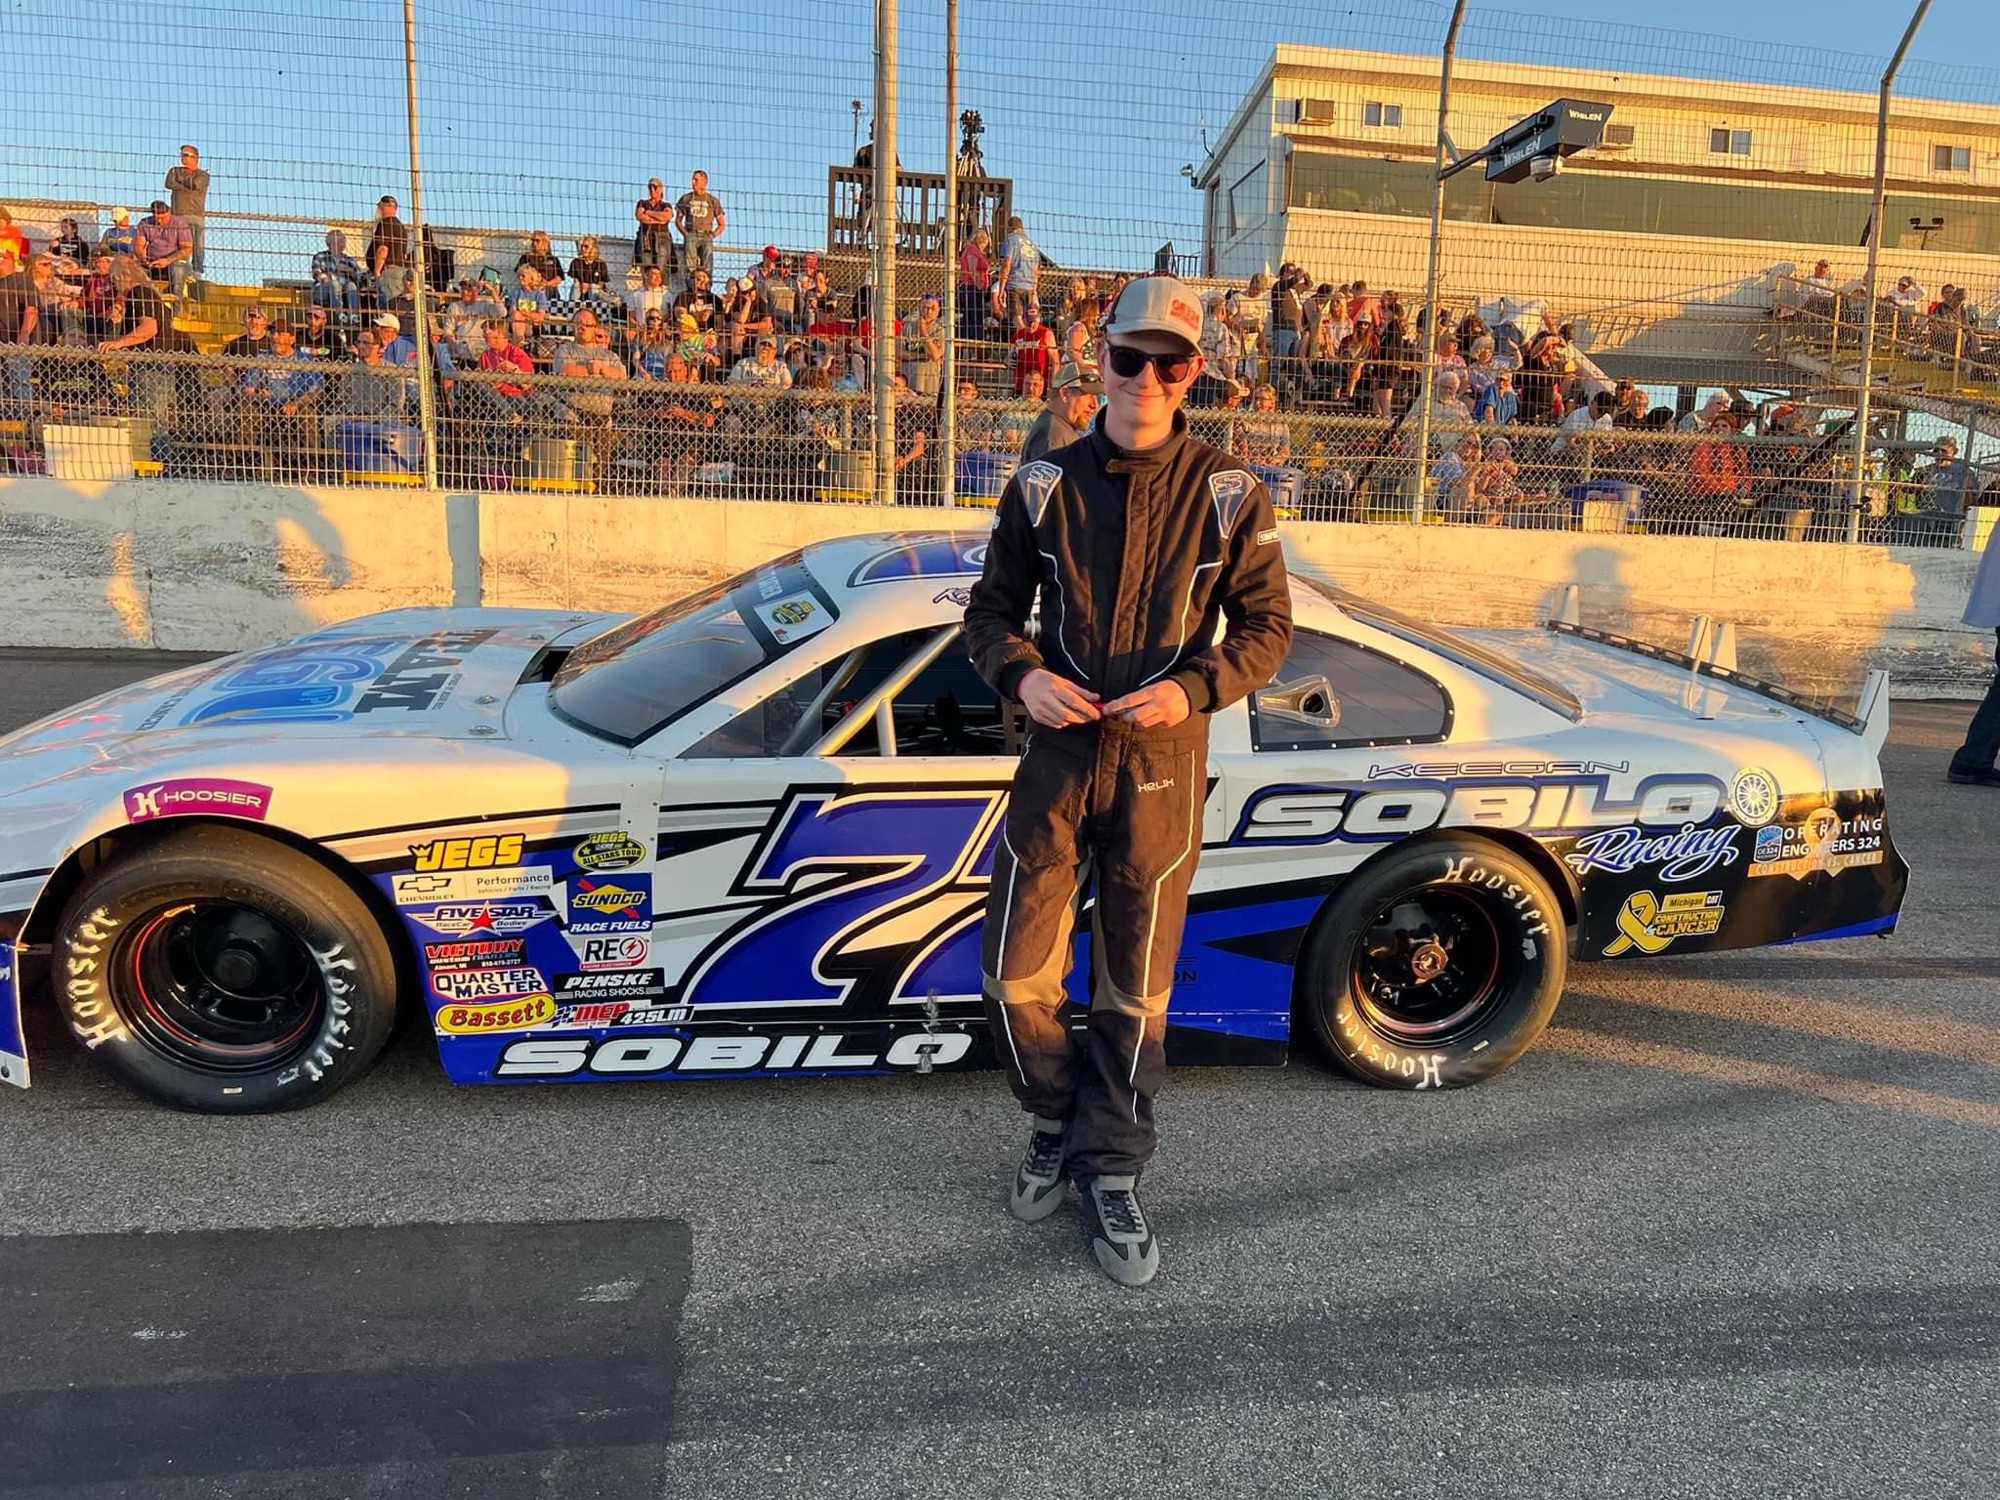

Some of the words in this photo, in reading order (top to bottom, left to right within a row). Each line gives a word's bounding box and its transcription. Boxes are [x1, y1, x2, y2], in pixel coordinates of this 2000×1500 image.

[1569, 109, 1602, 121] WHELEN
[1504, 137, 1541, 167] WHELEN
[353, 629, 501, 713] TEAM
[1368, 760, 1630, 780] KEEGAN
[163, 789, 263, 809] HOOSIER
[1240, 780, 1723, 839] SOBILO
[591, 832, 627, 844] JEGS
[1784, 819, 1883, 840] OPERATING
[1857, 836, 1881, 849] 324
[414, 834, 525, 873] JEGS
[622, 849, 642, 857] TOUR
[1566, 823, 1741, 882] Racing
[1844, 855, 1877, 867] CANCER
[476, 874, 550, 886] Performance
[400, 894, 454, 903] CHEVROLET
[575, 892, 646, 907] SUNOCO
[1443, 857, 1550, 936] Hoosier
[1669, 898, 1702, 906] Michigan
[1706, 895, 1719, 904] CAT
[436, 906, 483, 920] FIVE
[488, 906, 535, 918] STAR
[1655, 910, 1719, 924] CONSTRUCTION
[570, 922, 608, 933] RACE
[609, 920, 652, 931] FUELS
[1656, 920, 1717, 936] CANCER
[425, 939, 524, 959] VICTORY
[68, 907, 127, 1050] Hoosier
[435, 969, 537, 991] QUARTER
[563, 973, 654, 989] PENSKE
[455, 981, 543, 999] MASTER
[574, 988, 608, 998] RACING
[608, 986, 645, 997] SHOCKS
[308, 943, 357, 1082] Hoosier
[449, 999, 546, 1027] Bassett
[498, 1034, 972, 1075] SOBILO
[1336, 1010, 1447, 1089] Hoosier
